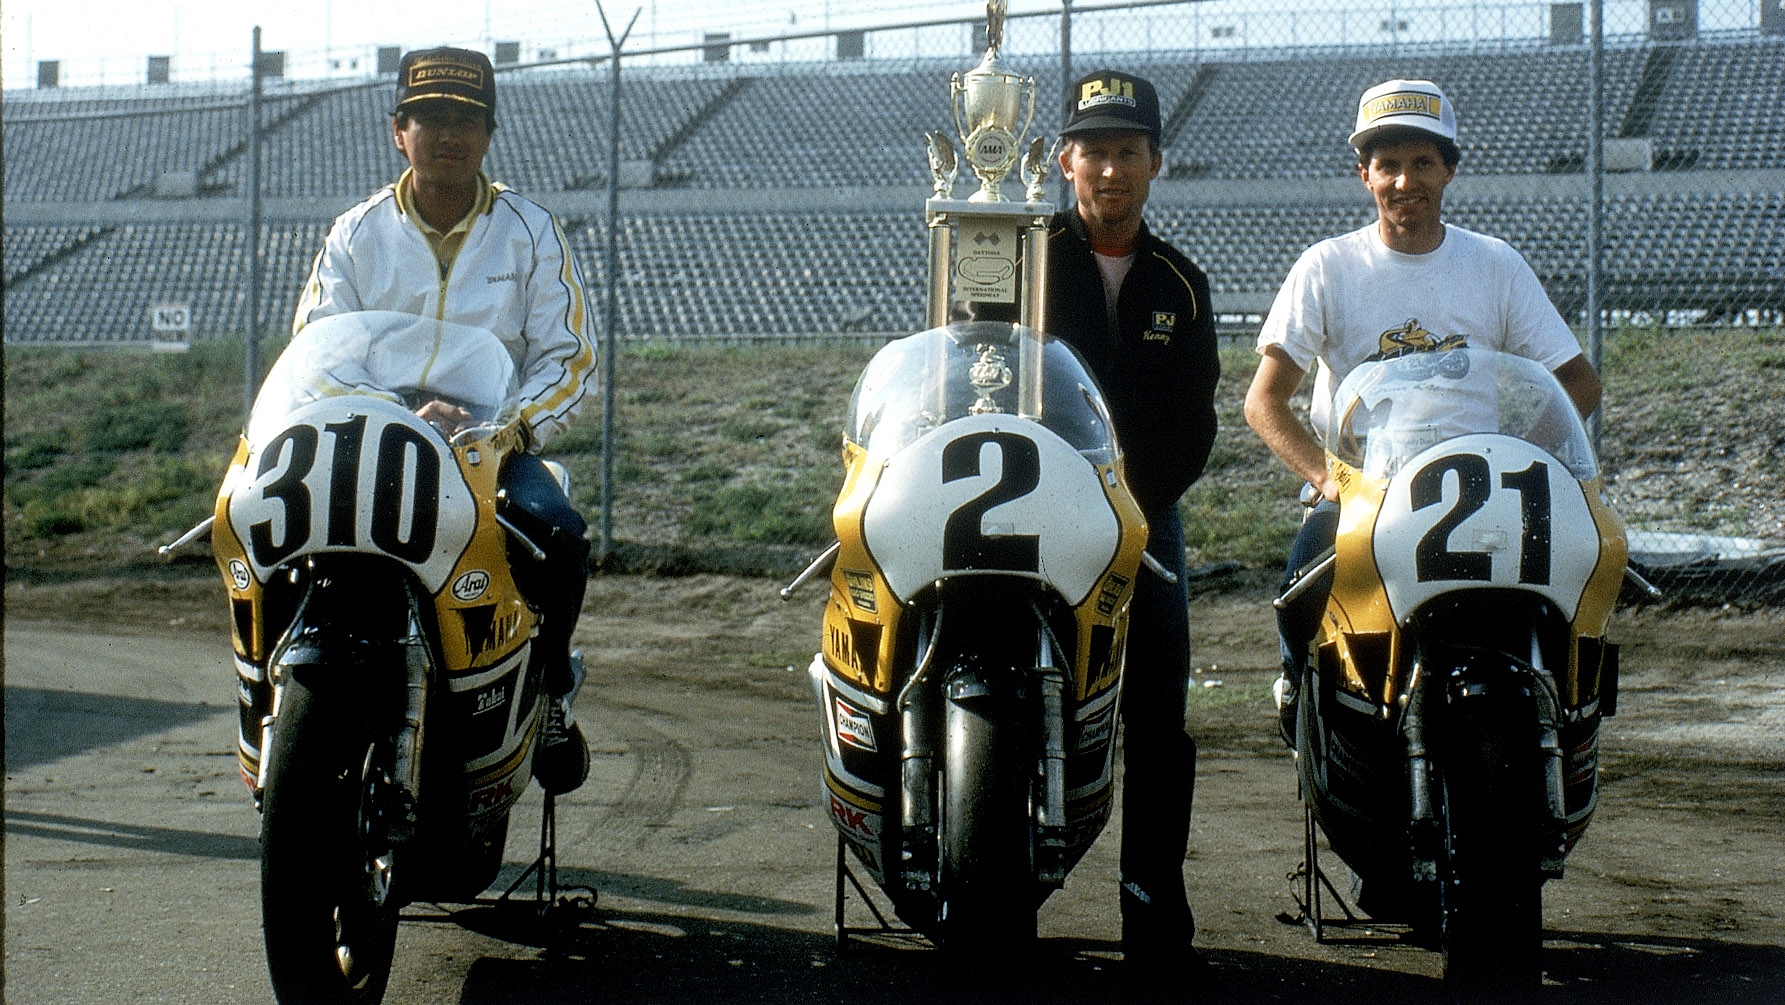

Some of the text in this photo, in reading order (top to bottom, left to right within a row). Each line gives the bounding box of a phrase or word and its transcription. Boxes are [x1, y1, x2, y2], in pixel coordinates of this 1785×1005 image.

[415, 68, 477, 79] DUNLOP
[1082, 78, 1134, 101] PJ1
[1372, 97, 1426, 112] YAMAHA
[157, 310, 186, 326] NO
[250, 415, 440, 568] 310
[941, 431, 1041, 573] 2
[1410, 453, 1552, 586] 21
[455, 574, 487, 593] Arai
[829, 623, 859, 671] YAMA
[839, 712, 871, 738] CHAMPION
[829, 793, 875, 836] RK
